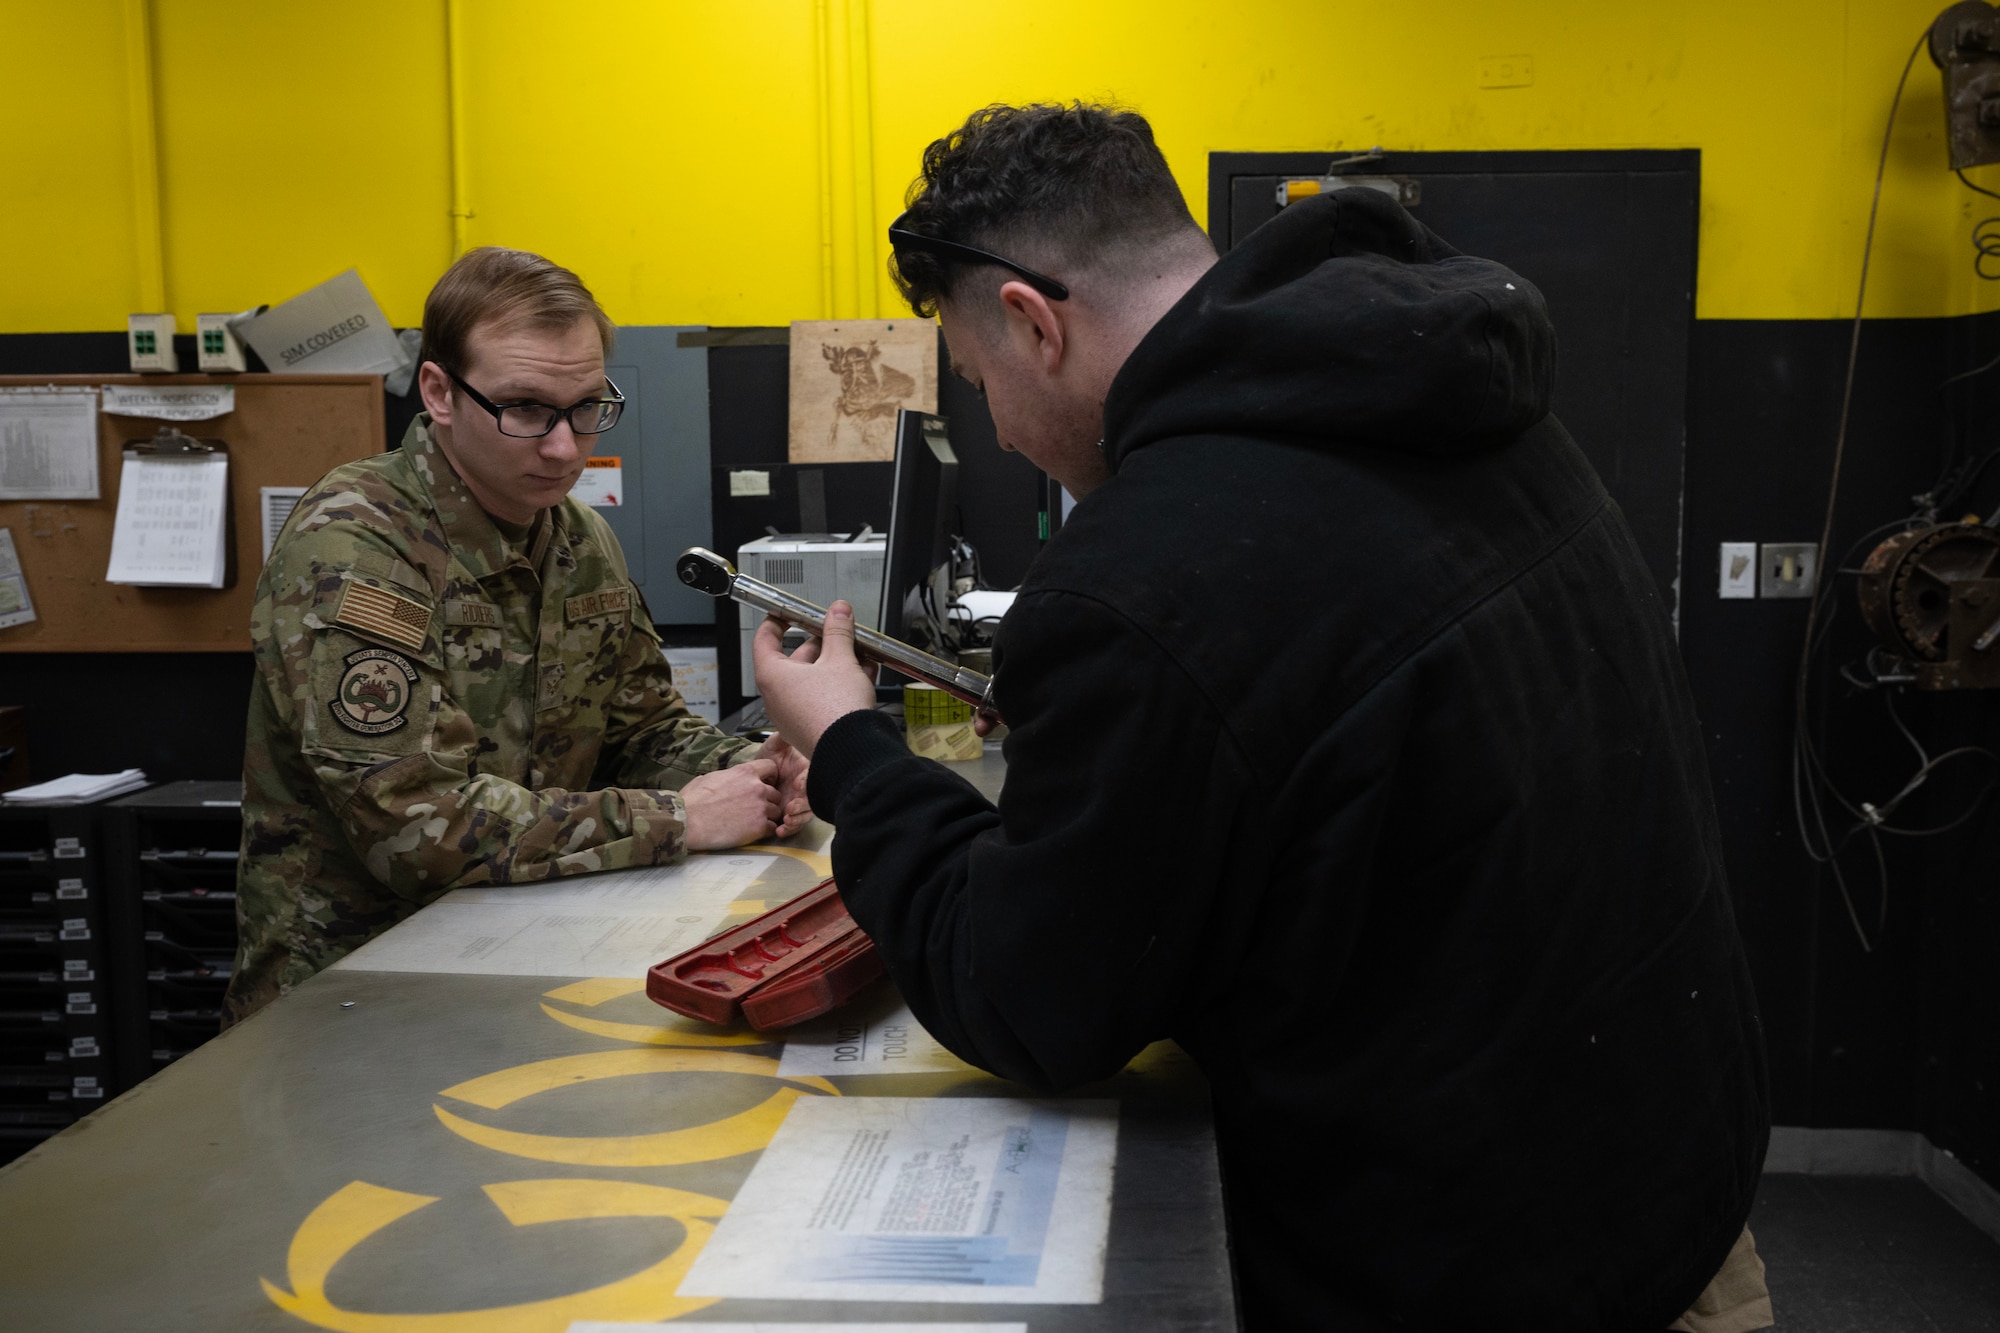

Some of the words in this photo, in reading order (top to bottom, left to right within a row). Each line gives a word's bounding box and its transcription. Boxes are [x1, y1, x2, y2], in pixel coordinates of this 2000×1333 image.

[280, 343, 307, 362] SIM
[306, 314, 367, 351] COVERED
[118, 393, 158, 405] WEEKLY
[159, 392, 220, 405] INSPECTION
[568, 605, 580, 619] US
[581, 600, 597, 616] AIR
[600, 591, 627, 611] FORCE
[373, 650, 398, 661] SEMPER
[340, 713, 360, 730] FIGHTER
[883, 1025, 907, 1061] TOUCH
[834, 1045, 859, 1062] DO
